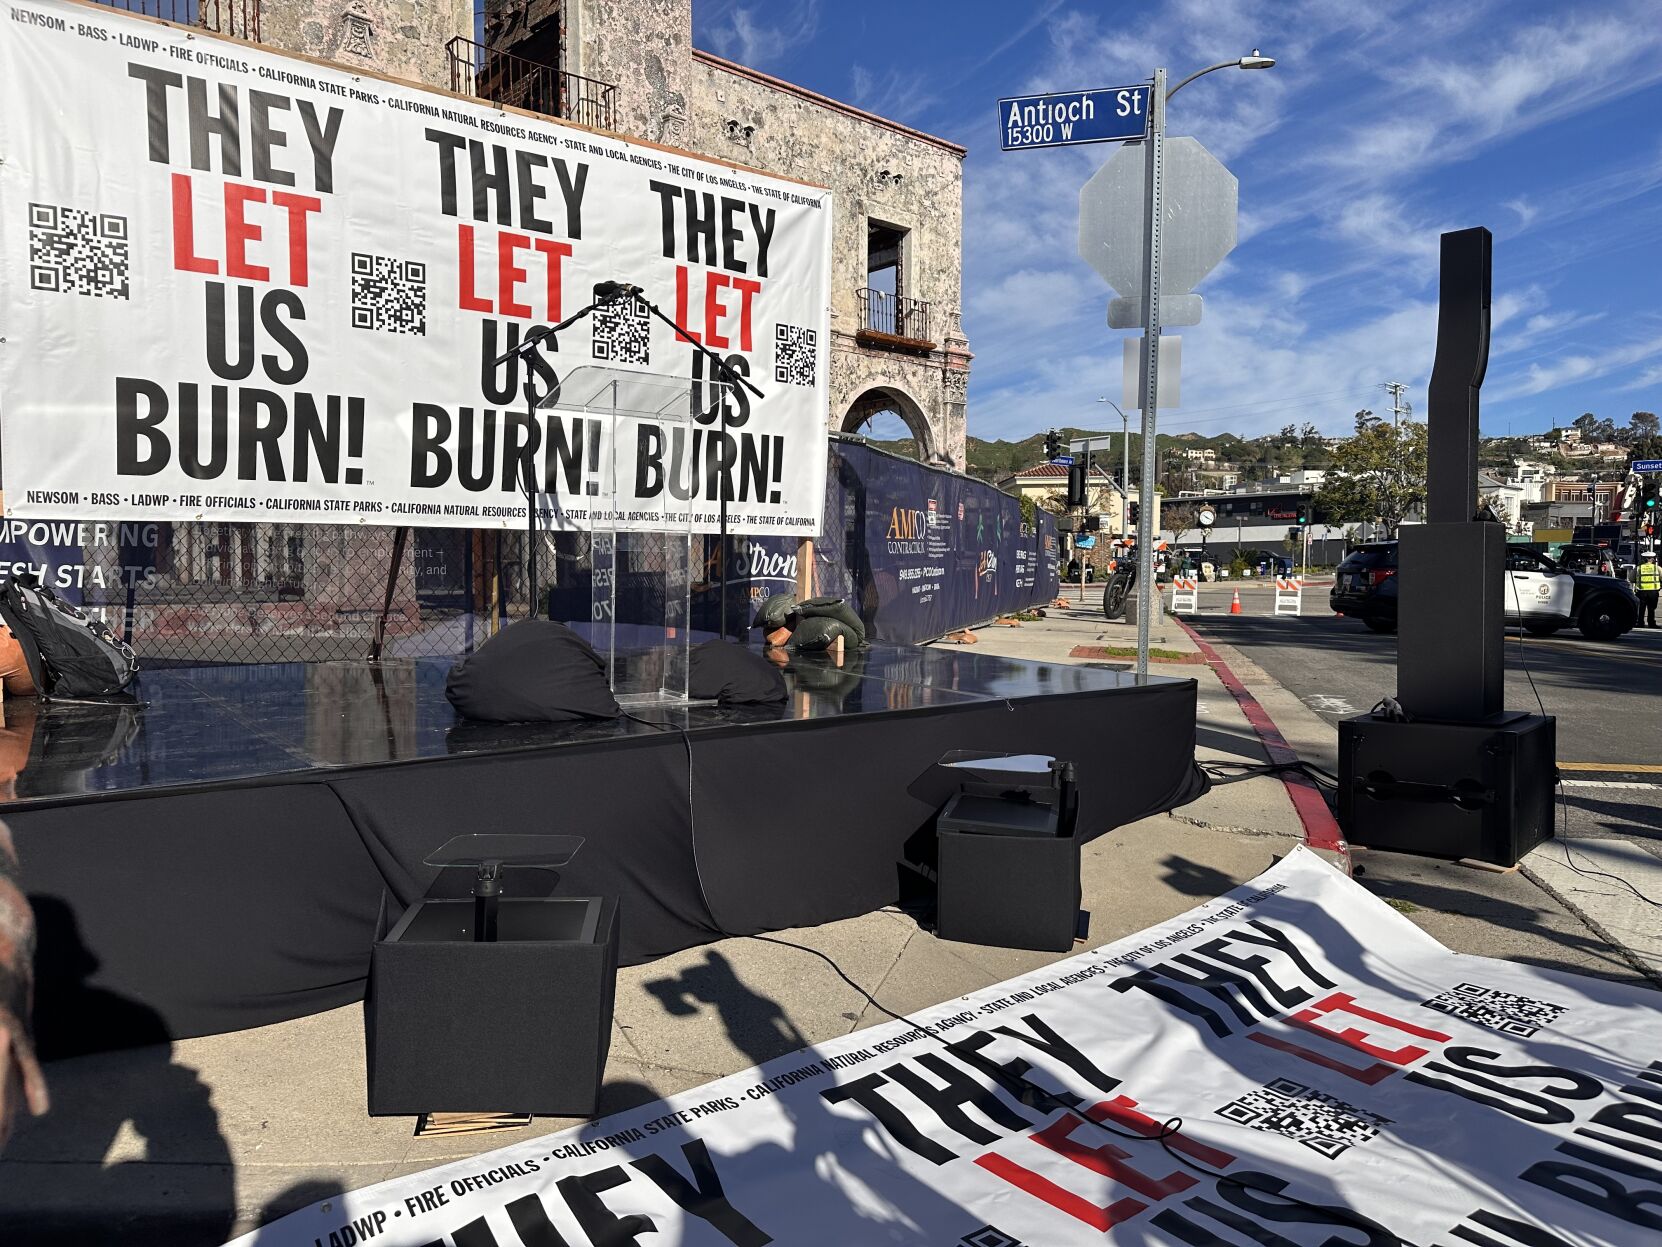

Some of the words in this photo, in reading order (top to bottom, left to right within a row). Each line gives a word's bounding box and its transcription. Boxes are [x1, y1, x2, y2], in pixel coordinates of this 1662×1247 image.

[11, 8, 65, 31] NEWSOM
[78, 24, 108, 41] BASS
[119, 33, 158, 52] LADWP
[170, 45, 193, 62] FIRE
[196, 52, 249, 74] OFFICIALS
[258, 66, 316, 90] CALIFORNIA
[318, 81, 347, 98] STATE
[350, 88, 380, 105] PARKS
[388, 98, 440, 118] CALIFORNIA
[442, 108, 478, 128] NATURAL
[480, 119, 526, 140] RESOURCES
[528, 131, 558, 146] AGENCY
[564, 138, 588, 152] STATE
[588, 144, 604, 156] AND
[605, 148, 628, 162] LOCAL
[630, 154, 662, 170] AGENCIES
[668, 164, 680, 175] THE
[682, 168, 694, 180] CITY
[696, 172, 704, 182] OF
[706, 174, 718, 185] LOS
[720, 178, 746, 192] ANGELES
[751, 185, 764, 195] THE
[764, 188, 782, 201] STATE
[782, 192, 790, 202] OF
[128, 62, 344, 194] THEY
[1008, 96, 1094, 128] Antioch
[1116, 90, 1142, 117] St
[1008, 124, 1054, 145] 15300
[1061, 122, 1074, 140] W
[171, 172, 322, 287] LET
[425, 128, 589, 240] THEY
[649, 179, 776, 278] THEY
[458, 224, 572, 323] LET
[675, 265, 761, 352] LET
[205, 281, 309, 385] US
[481, 319, 560, 409] US
[116, 376, 365, 486] BURN!
[691, 350, 750, 428] US
[410, 402, 602, 496] BURN!
[634, 423, 784, 504] BURN!
[1636, 462, 1662, 470] Sunset
[27, 491, 79, 504] NEWSOM
[91, 493, 120, 506] BASS
[132, 494, 170, 506] LADWP
[180, 495, 202, 507] FIRE
[205, 496, 256, 508] OFFICIALS
[266, 498, 321, 510] CALIFORNIA
[324, 500, 350, 511] STATE
[353, 501, 382, 512] PARKS
[391, 502, 442, 514] CALIFORNIA
[444, 504, 480, 516] NATURAL
[482, 506, 526, 518] RESOURCES
[533, 508, 558, 519] GENCY
[566, 510, 588, 520] STATE
[628, 512, 660, 521] AGENCIES
[665, 512, 676, 522] THE
[694, 514, 702, 523] OF
[704, 514, 716, 524] LOS
[746, 516, 758, 524] THE
[758, 516, 776, 525] STATE
[776, 516, 784, 526] OF
[54, 564, 156, 590] STARTS
[426, 564, 446, 576] and
[1108, 920, 1338, 1038] THEY
[404, 1185, 450, 1217] FIRE
[450, 1159, 540, 1196] OFFICIALS
[552, 1128, 644, 1160] CALIFORNIA
[644, 1110, 692, 1134] STATE
[688, 1096, 740, 1118] PARKS
[746, 1062, 824, 1100] CALIFORNIA
[822, 1048, 878, 1072] NATURAL
[935, 1011, 979, 1032] AGENCY
[980, 998, 1016, 1014] STATE
[1010, 991, 1034, 1004] AND
[1030, 982, 1065, 996] LOCAL
[1060, 965, 1106, 986] AGENCIES
[1107, 956, 1126, 969] THE
[1122, 948, 1145, 962] CITY
[1142, 945, 1156, 954] OF
[1152, 938, 1171, 950] LOS
[1166, 924, 1205, 944] ANGELES
[1216, 904, 1240, 920] STATE
[1246, 992, 1452, 1085] LET
[1403, 1046, 1604, 1124] US
[819, 1013, 1122, 1166] THEY
[410, 1138, 774, 1247] EY
[973, 1094, 1237, 1233] LET
